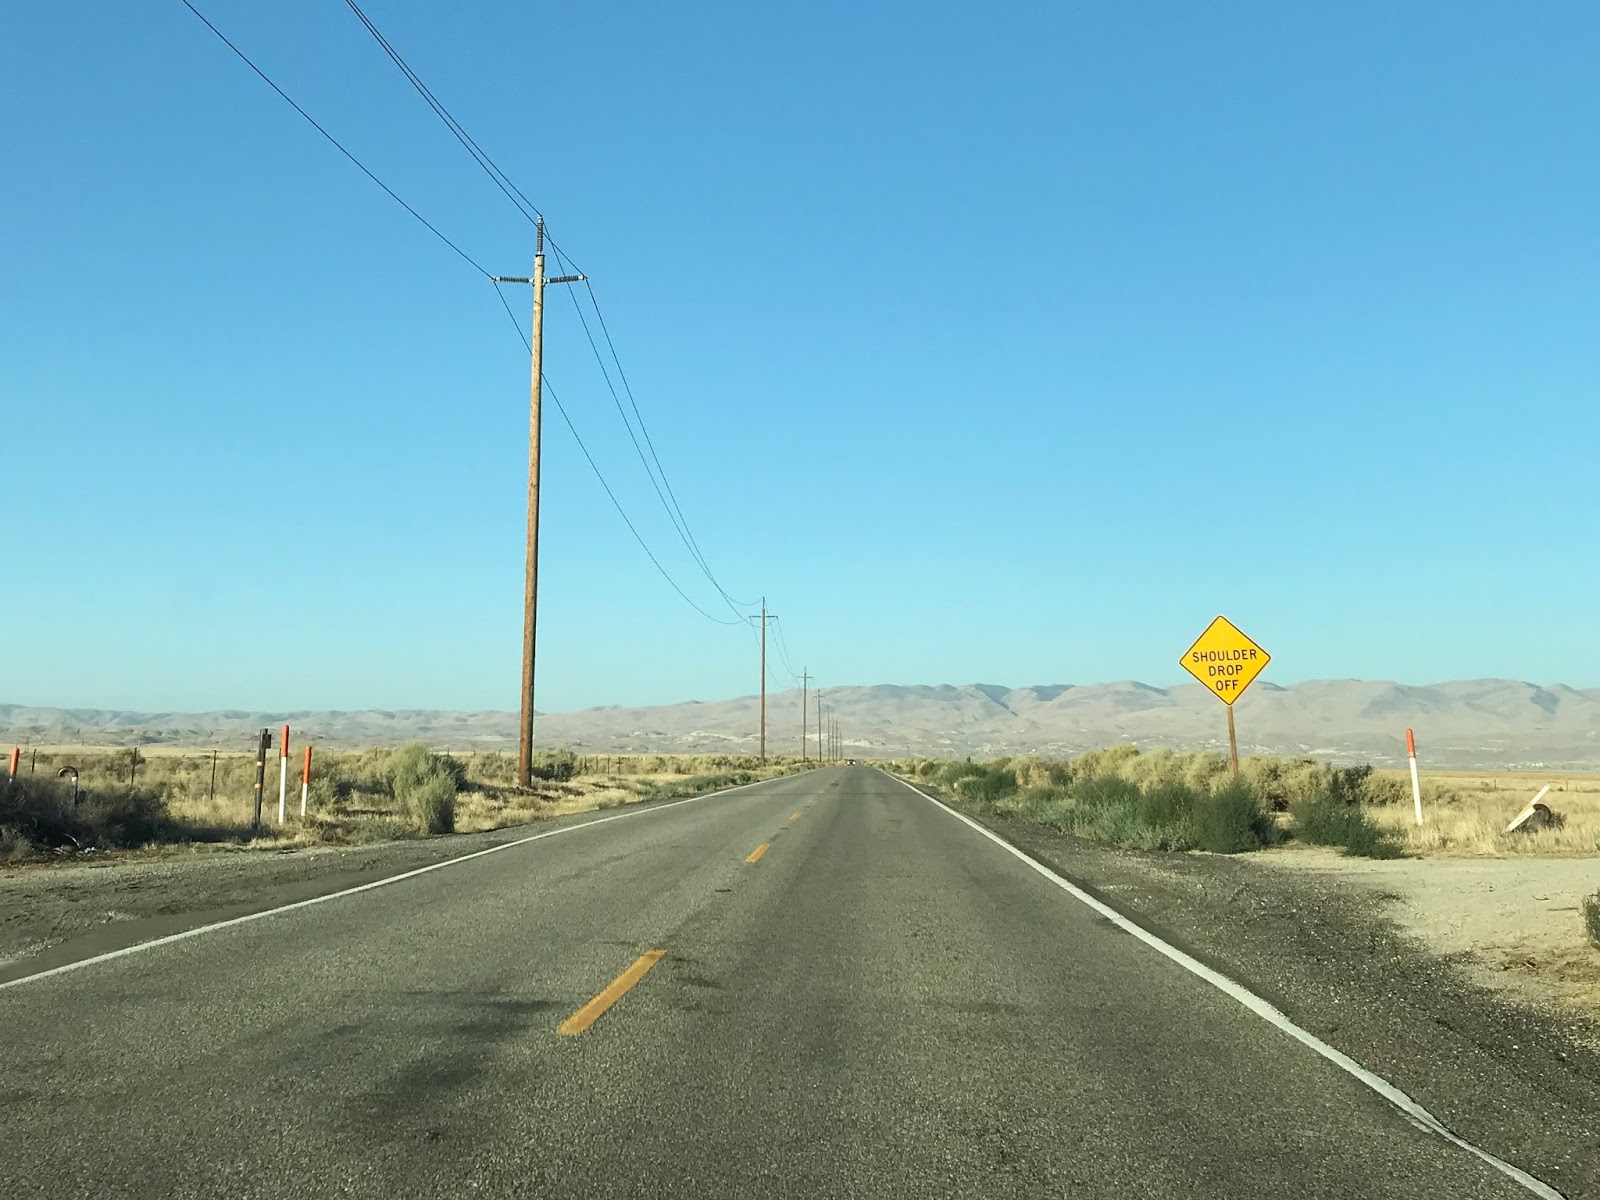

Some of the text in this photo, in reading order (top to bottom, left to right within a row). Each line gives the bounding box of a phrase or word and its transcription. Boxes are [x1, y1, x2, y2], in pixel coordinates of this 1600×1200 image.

[1192, 649, 1257, 663] SHOULDER
[1208, 664, 1243, 677] DROP
[1215, 680, 1239, 691] OFF
